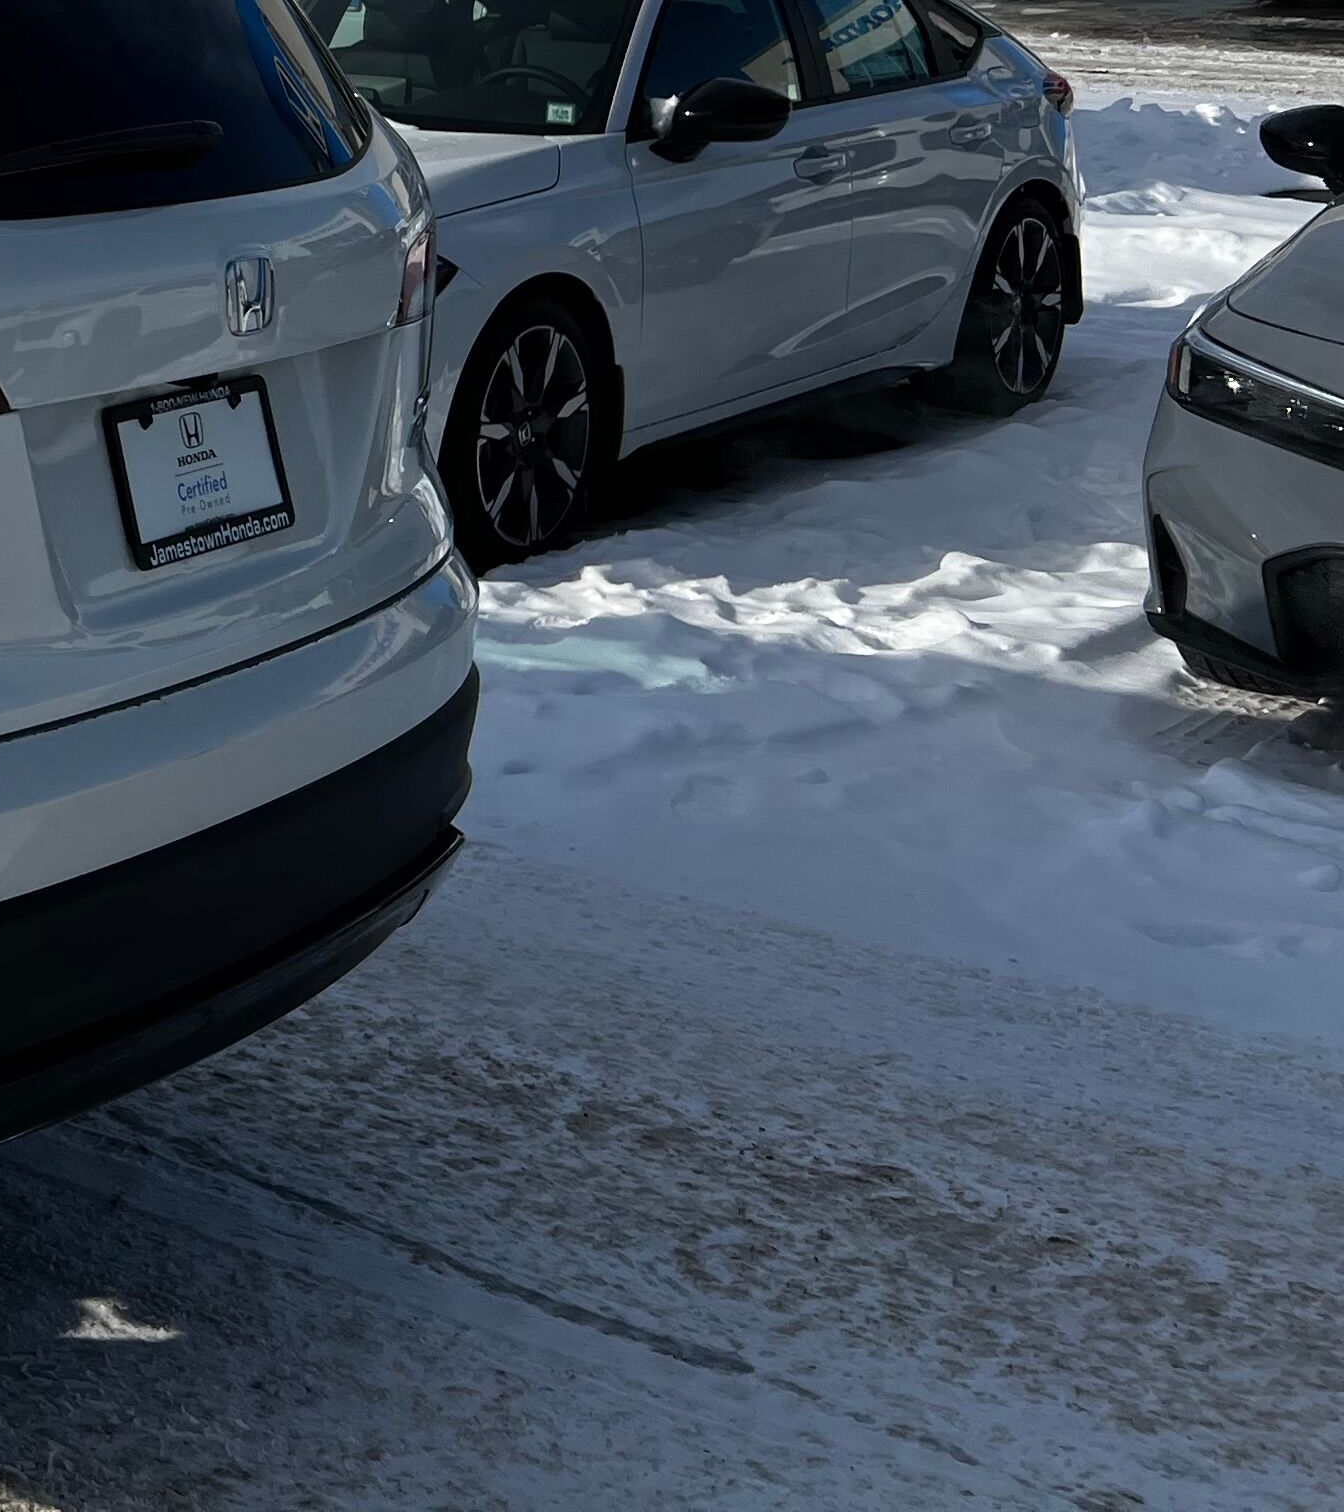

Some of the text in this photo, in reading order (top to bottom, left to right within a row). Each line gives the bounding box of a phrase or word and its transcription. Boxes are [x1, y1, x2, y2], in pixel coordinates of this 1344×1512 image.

[177, 448, 217, 467] HONDA
[177, 470, 228, 501] Certified
[150, 511, 290, 566] JamestownHonda.com
